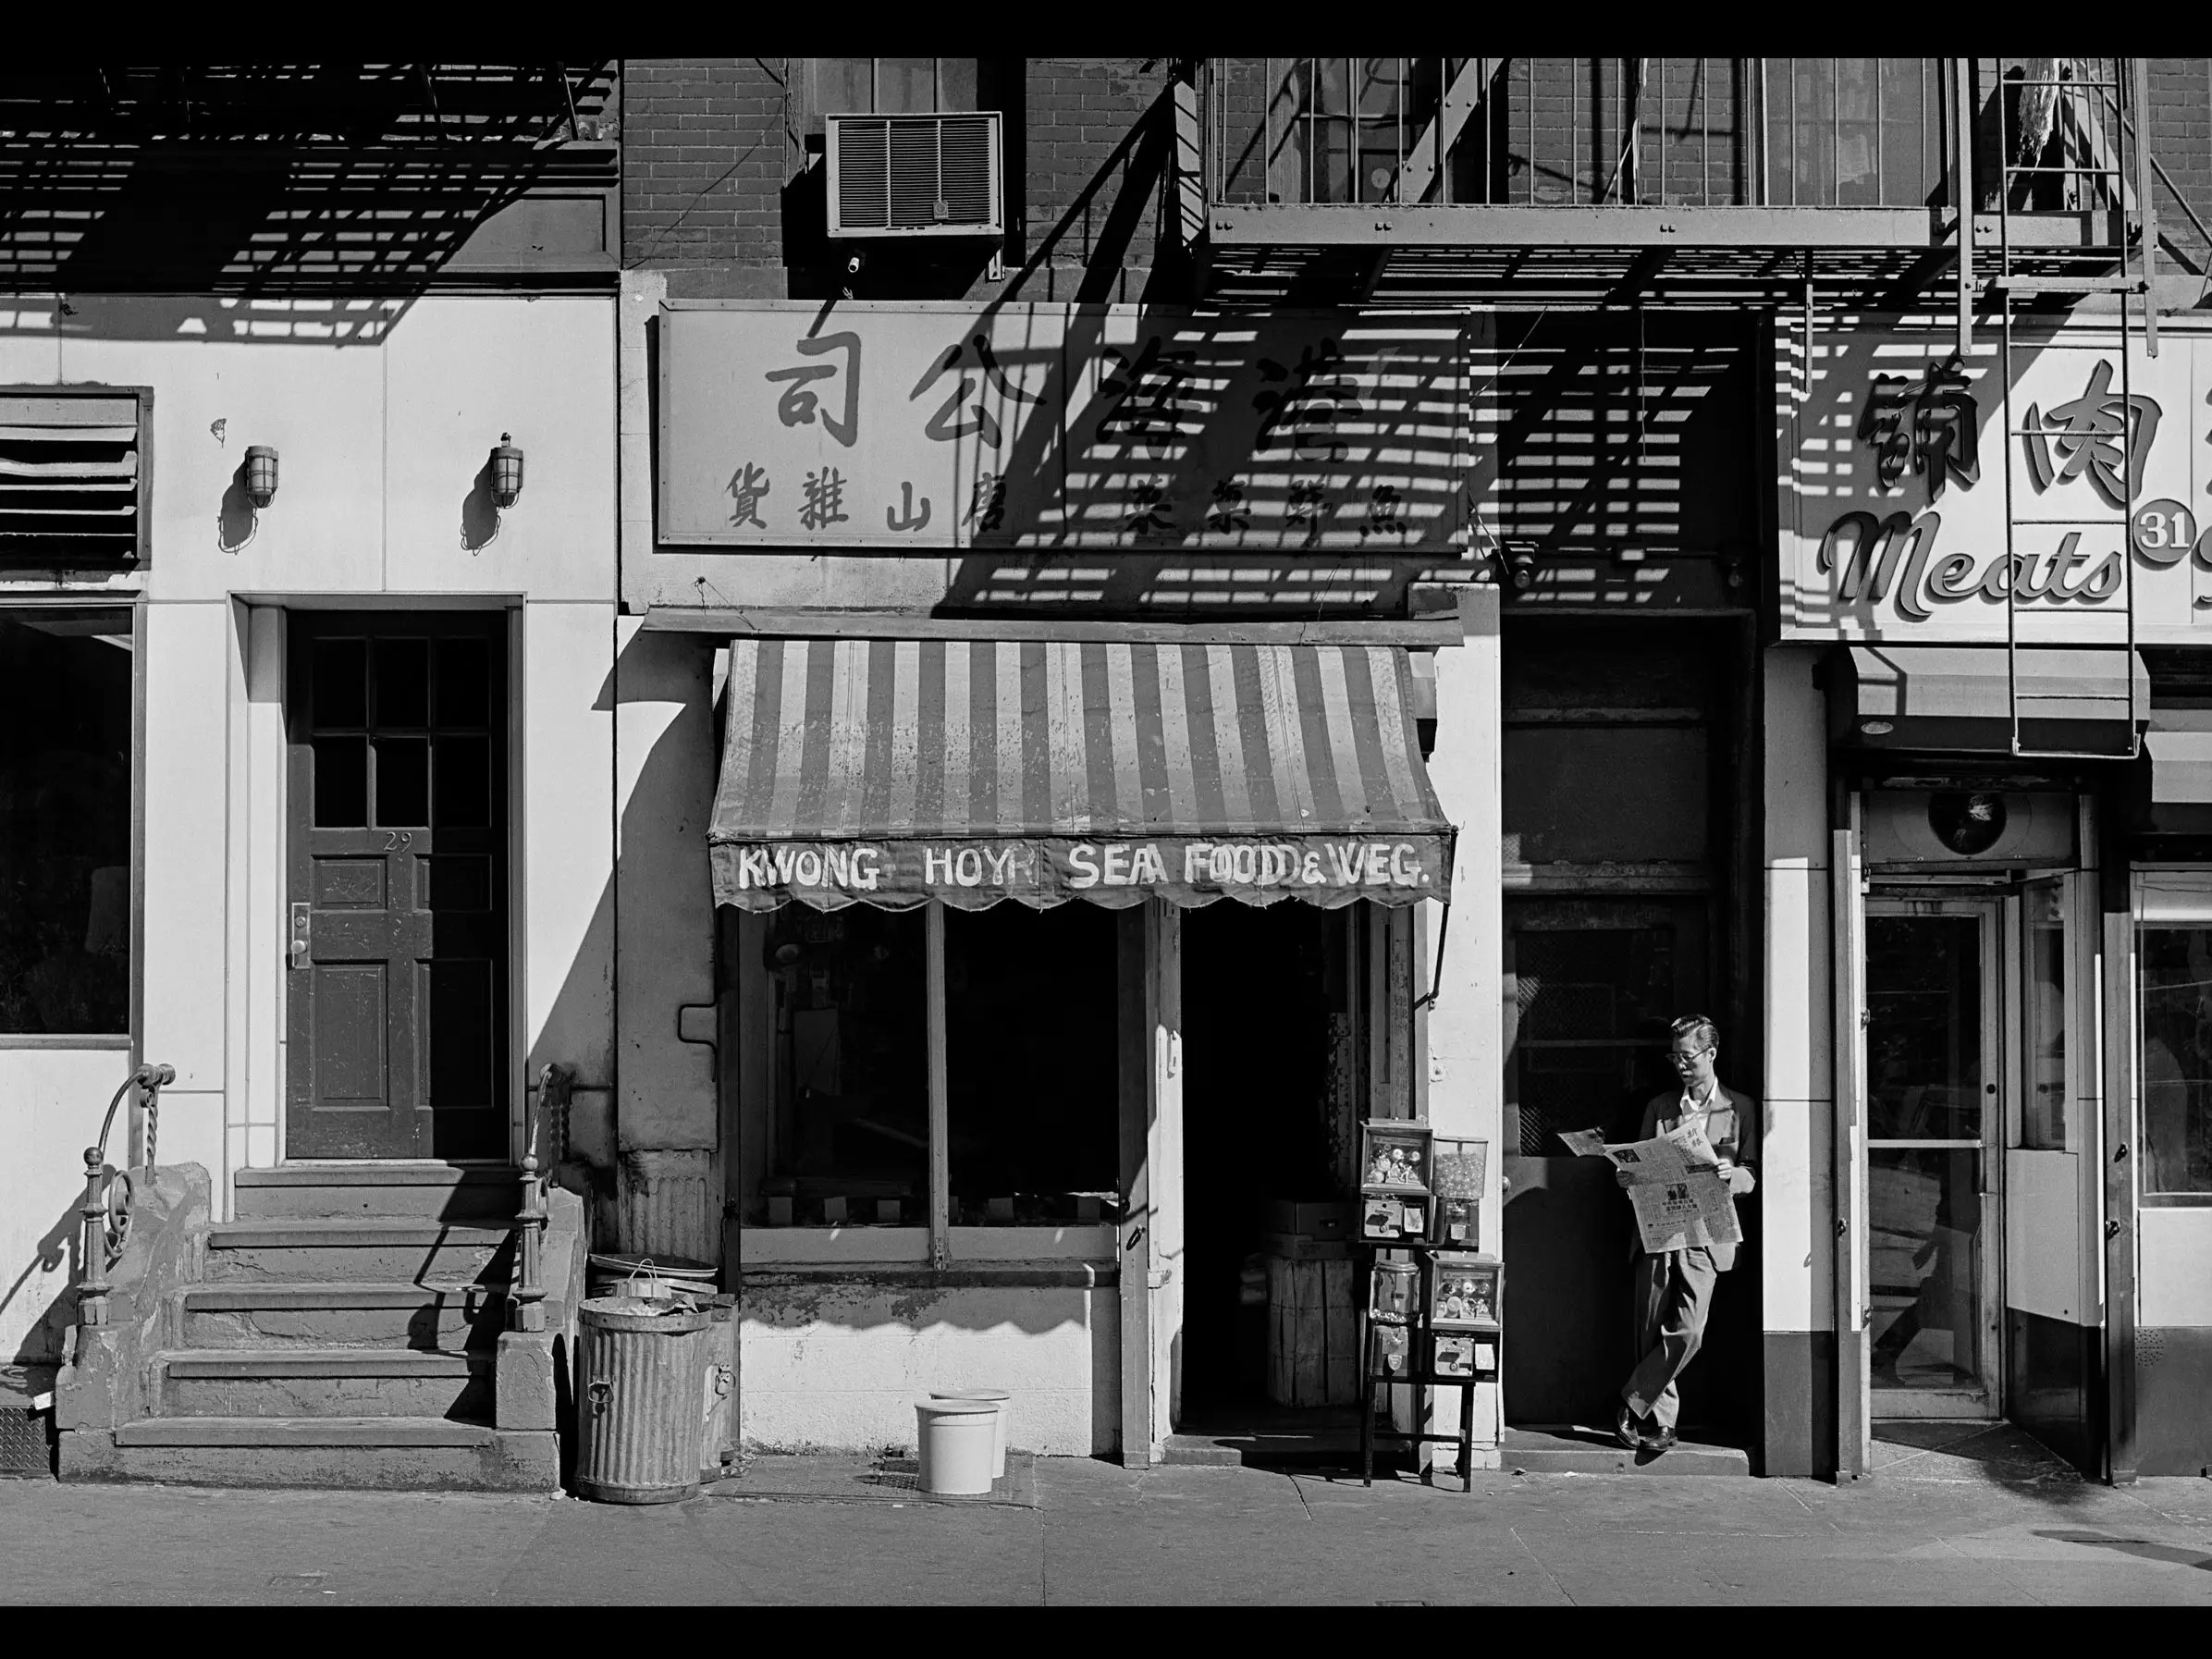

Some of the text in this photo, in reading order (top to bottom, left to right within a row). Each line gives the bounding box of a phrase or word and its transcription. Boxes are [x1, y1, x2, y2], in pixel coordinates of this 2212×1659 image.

[2140, 511, 2191, 550] 31
[1819, 510, 2123, 619] Meats
[383, 830, 412, 854] 29
[739, 847, 880, 890] KWONG
[1069, 842, 1170, 889] SEA
[1184, 842, 1296, 886] FOOD
